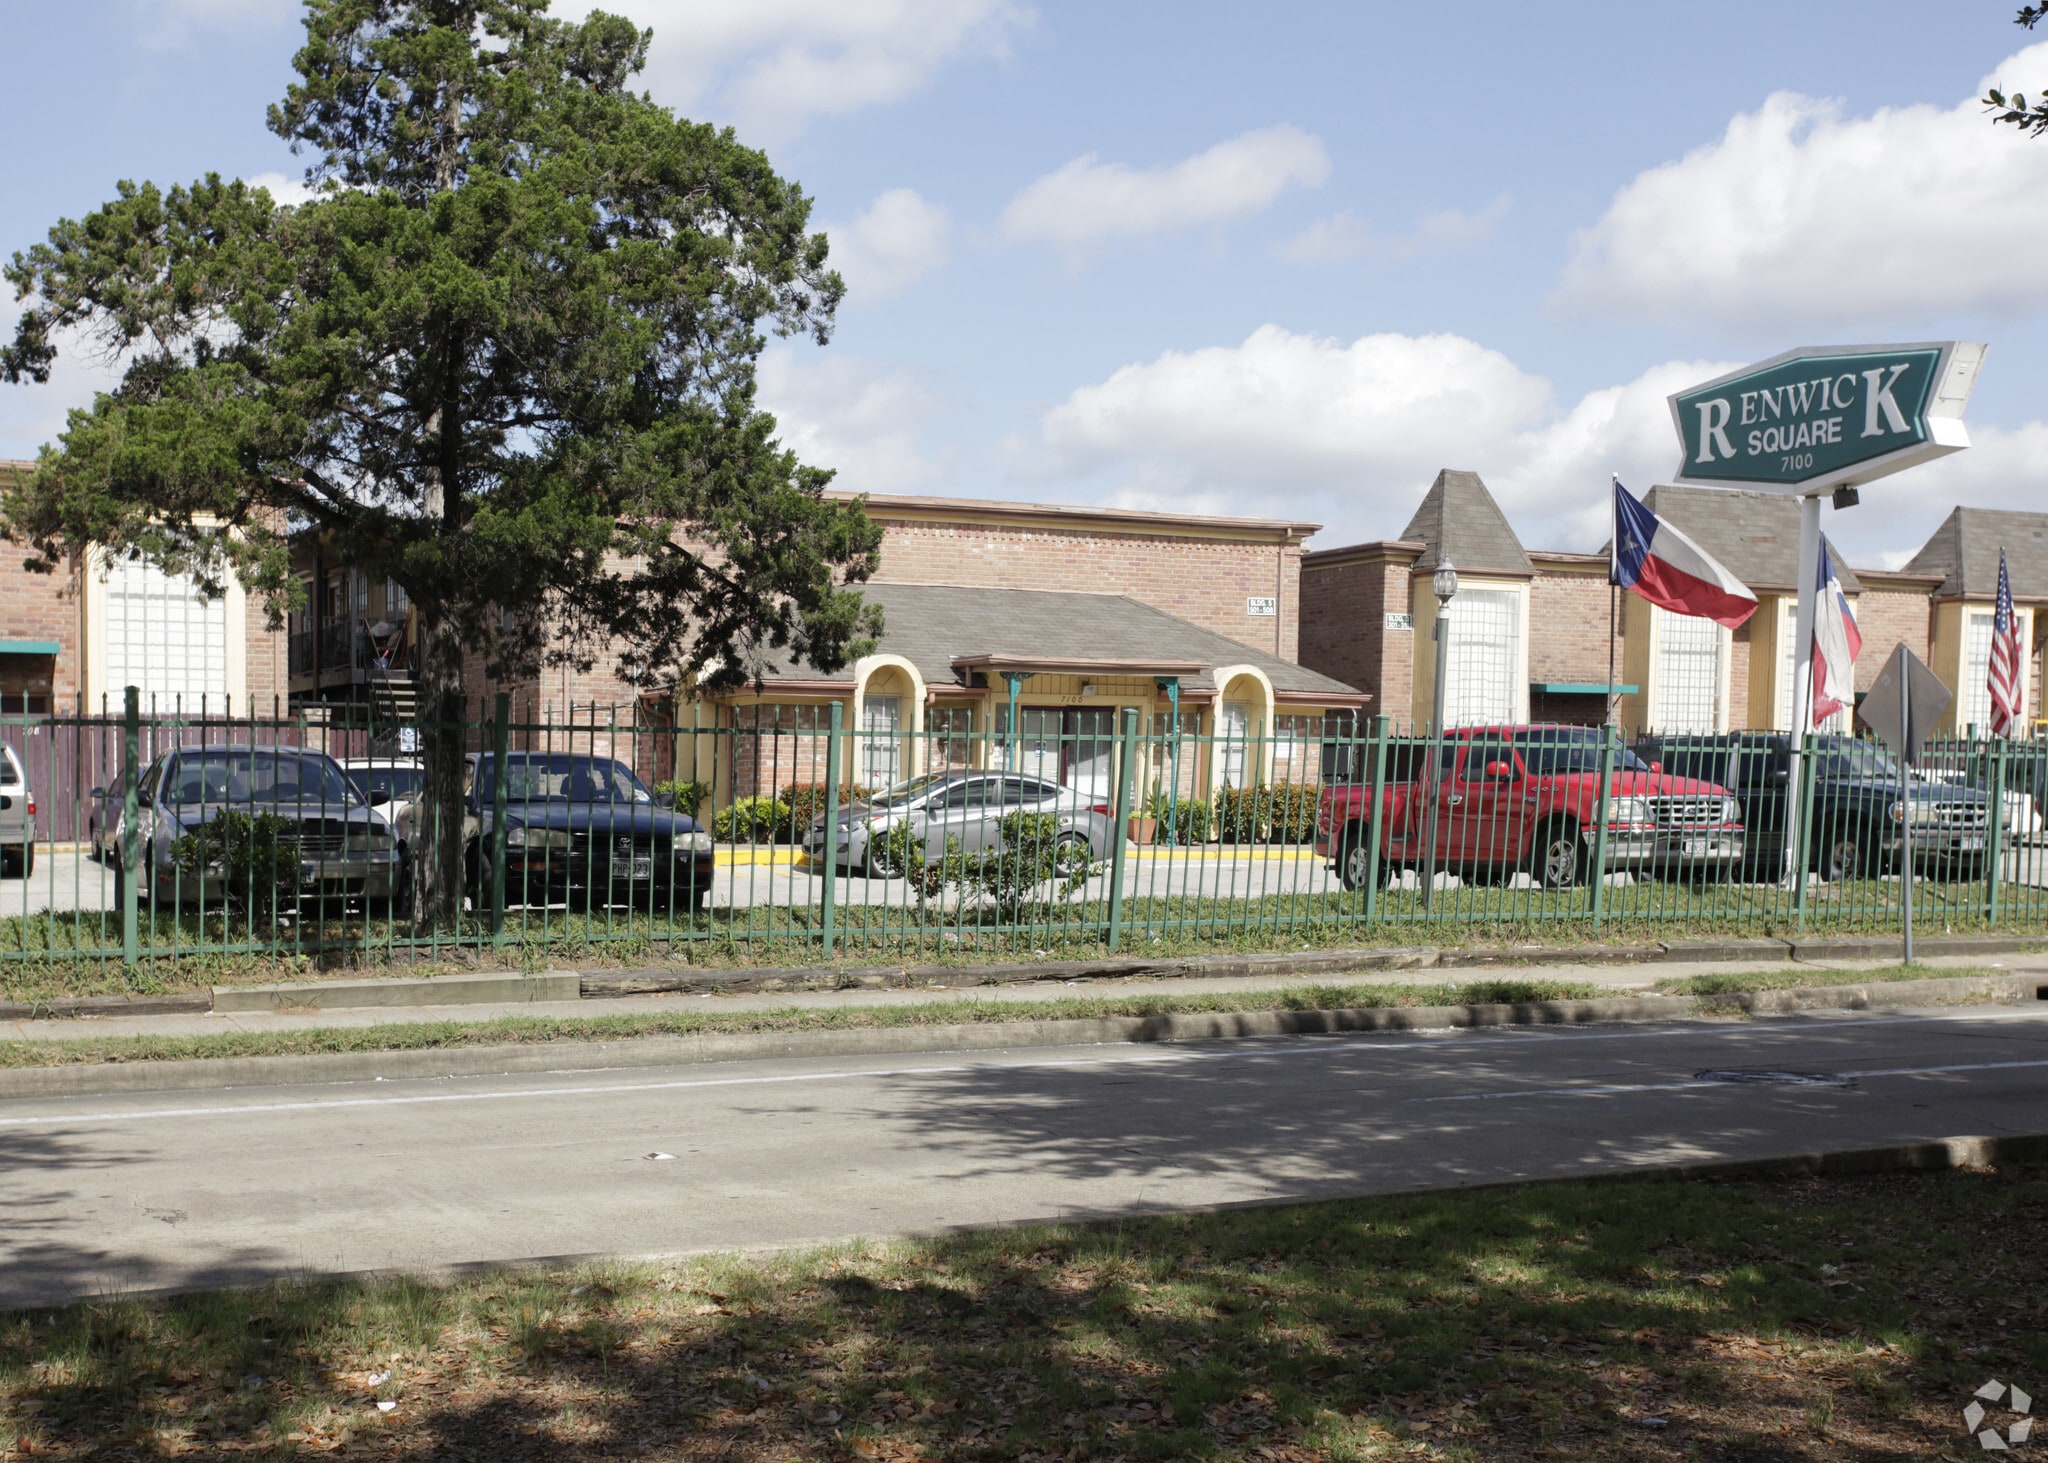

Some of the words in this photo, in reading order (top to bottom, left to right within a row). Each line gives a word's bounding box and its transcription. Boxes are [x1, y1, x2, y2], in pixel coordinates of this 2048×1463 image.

[1694, 362, 1911, 465] RENWICK
[1747, 416, 1843, 456] SQUARE
[1781, 453, 1813, 472] 7100
[1061, 695, 1083, 703] 7100
